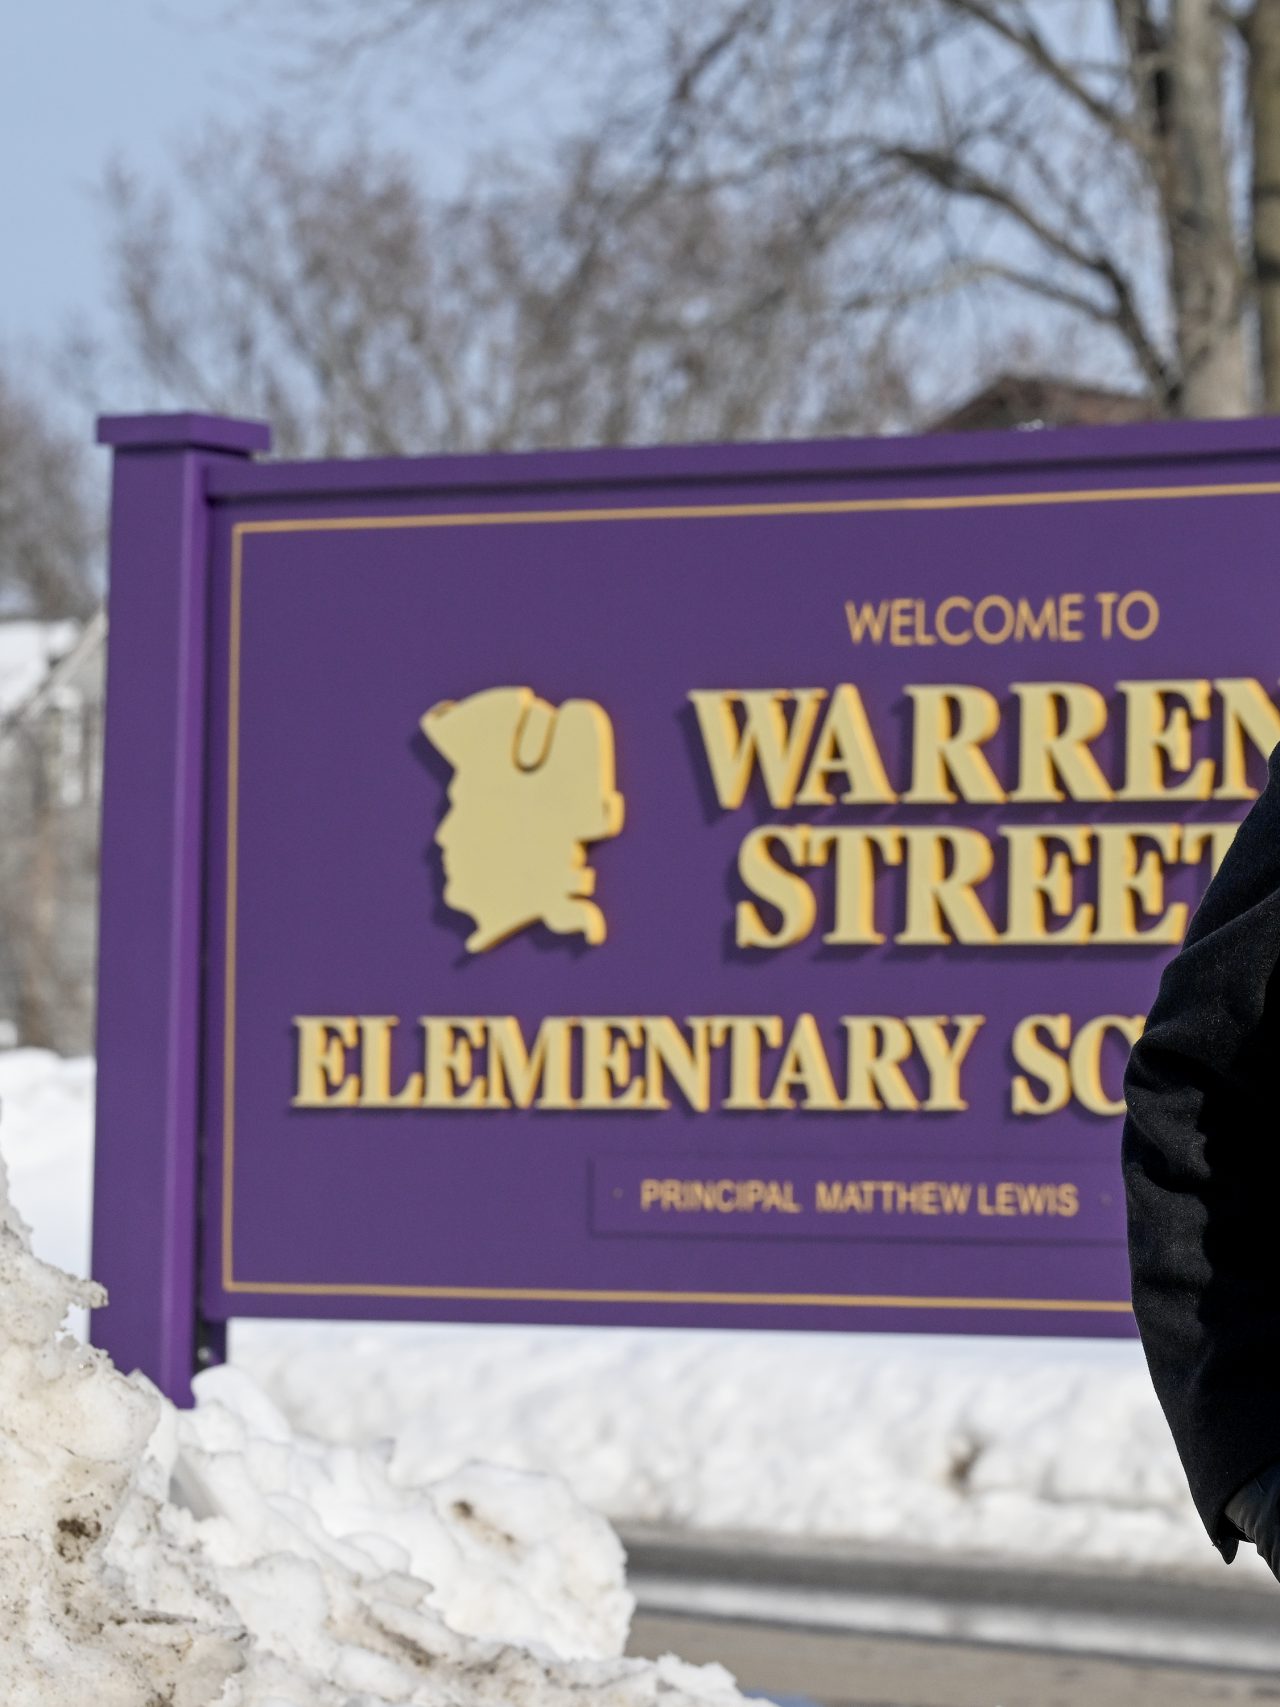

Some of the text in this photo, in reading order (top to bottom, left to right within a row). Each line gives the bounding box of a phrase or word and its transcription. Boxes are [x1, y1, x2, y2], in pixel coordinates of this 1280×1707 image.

[846, 590, 1159, 645] WELCOME TO
[291, 1013, 984, 1112] ELEMENTARY
[640, 1179, 1080, 1216] PRINCIPAL MATTHEW LEWIS
